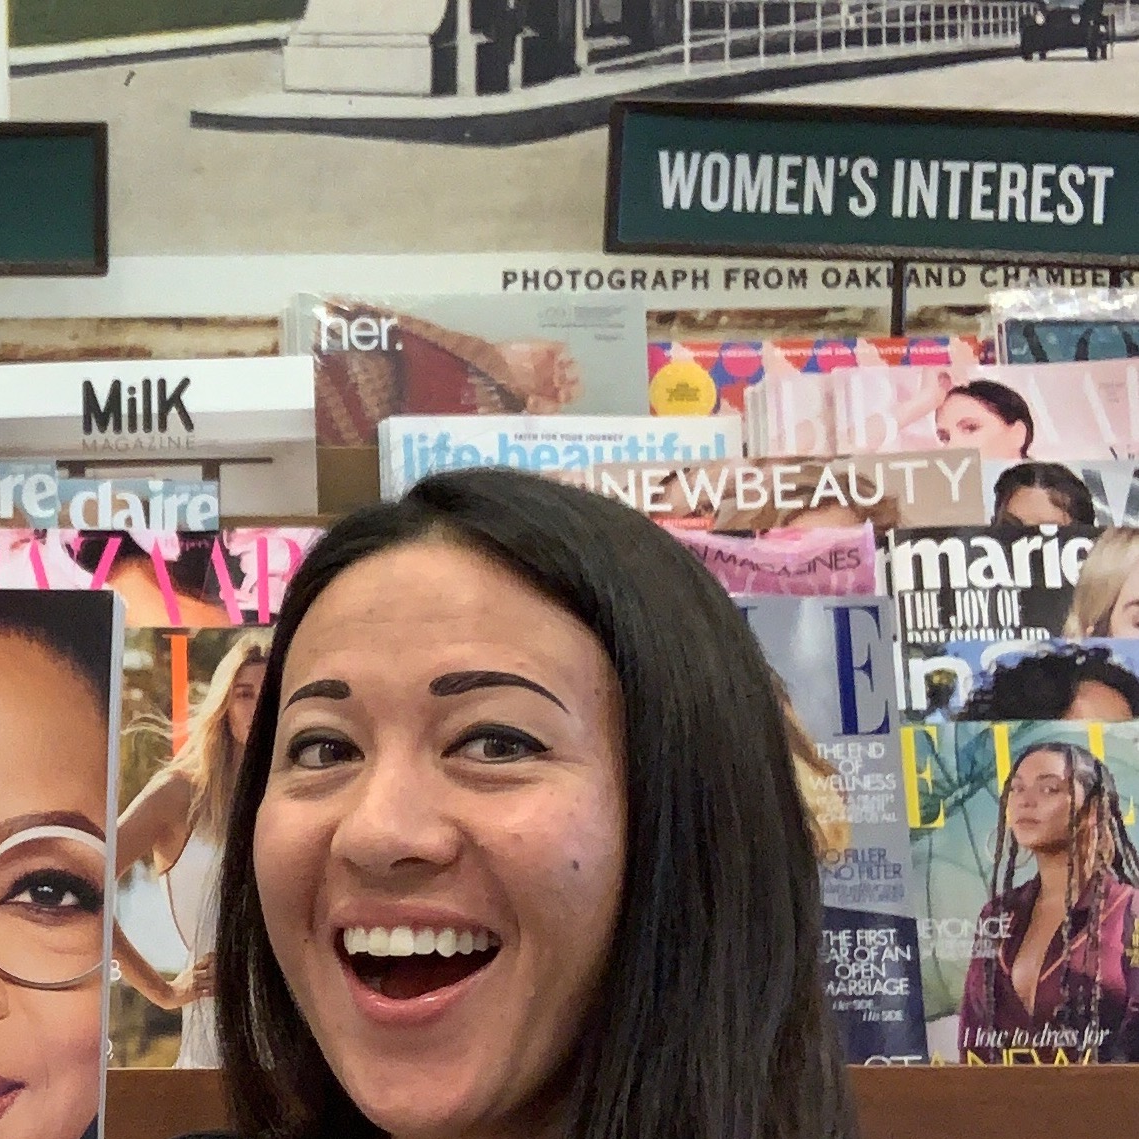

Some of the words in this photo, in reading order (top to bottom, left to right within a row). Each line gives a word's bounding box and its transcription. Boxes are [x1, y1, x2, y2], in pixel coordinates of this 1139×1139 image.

[659, 149, 879, 218] WOMEN'S
[892, 158, 1114, 226] INTEREST
[502, 268, 710, 291] PHOTOGRAPH
[724, 268, 808, 290] FROM
[81, 435, 196, 453] MAGAZINE
[69, 480, 219, 531] claire
[822, 929, 852, 948] THE
[856, 928, 896, 945] FIRST
[854, 947, 879, 963] OF
[883, 946, 911, 962] AN
[835, 964, 886, 980] OPEN
[1011, 1026, 1029, 1049] to
[1033, 1021, 1079, 1048] dress
[1082, 1024, 1111, 1049] for
